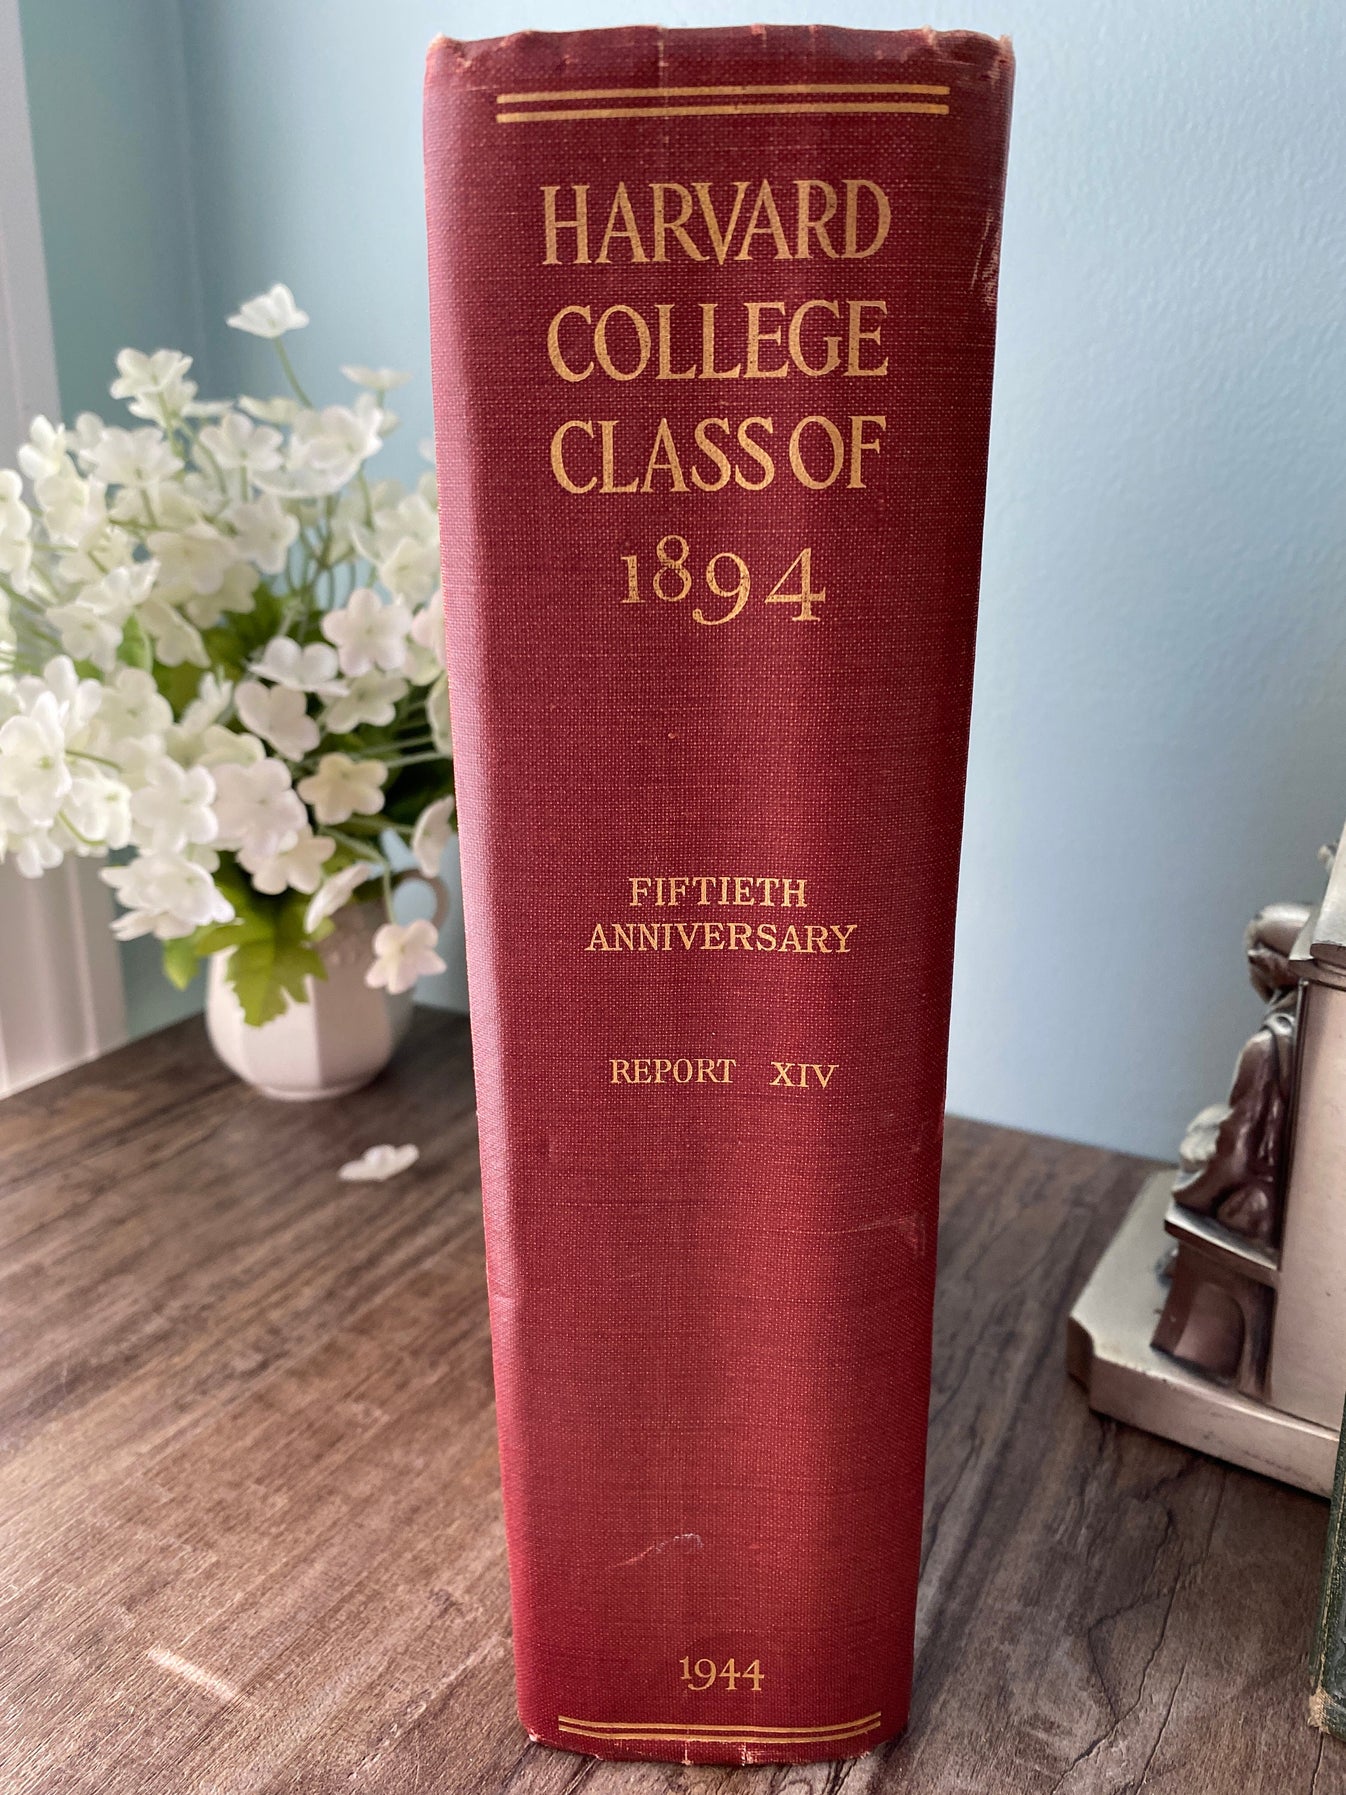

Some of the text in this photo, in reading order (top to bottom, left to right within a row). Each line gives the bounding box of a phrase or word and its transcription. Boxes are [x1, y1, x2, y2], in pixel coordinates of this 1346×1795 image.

[541, 179, 892, 265] HARVARD
[547, 300, 889, 382] COLLEGE
[550, 415, 887, 494] CLASS OF
[620, 535, 826, 626] 1894
[629, 877, 807, 908] FIFTIETH
[585, 923, 858, 954] ANNIVERSARY
[610, 1058, 839, 1088] REPORT XIV
[680, 1656, 766, 1691] 1944
